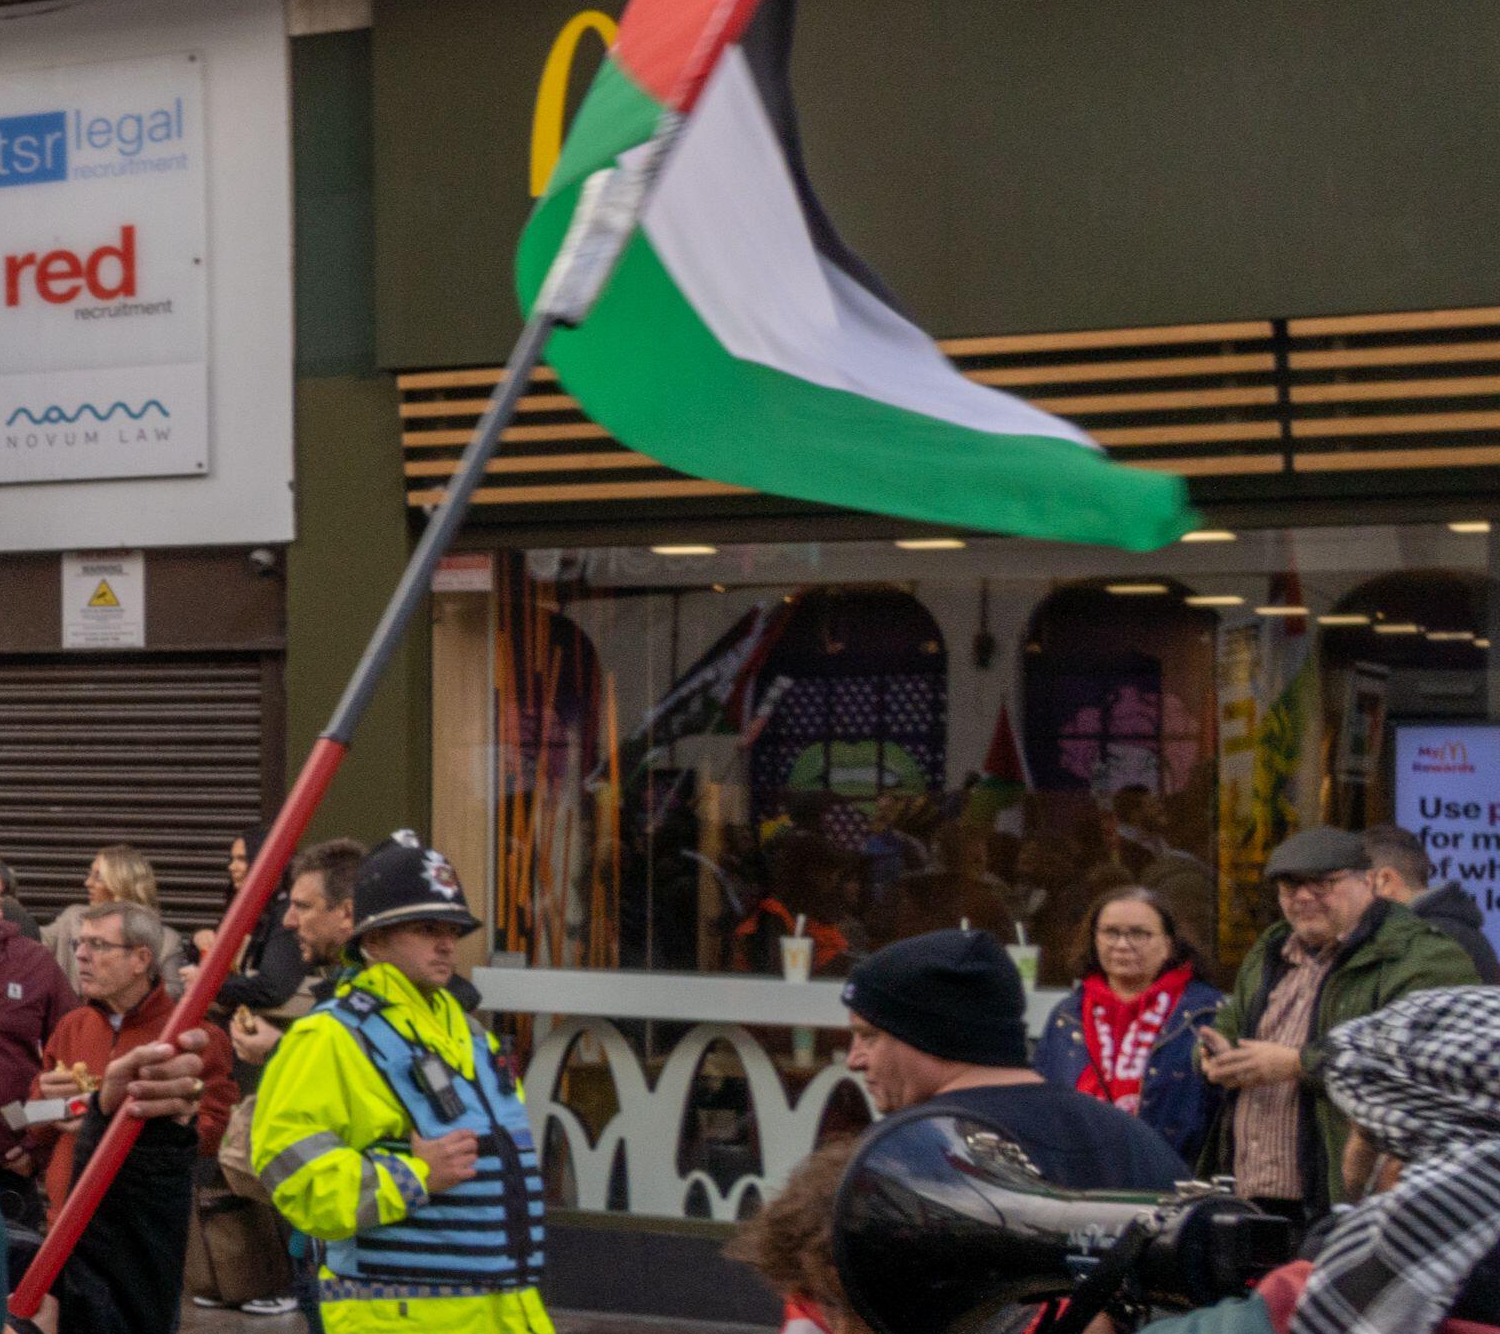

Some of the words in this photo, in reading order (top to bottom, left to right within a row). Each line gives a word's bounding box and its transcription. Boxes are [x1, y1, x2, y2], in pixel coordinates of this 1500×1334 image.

[75, 97, 183, 156] legal
[5, 225, 138, 307] red
[75, 299, 173, 320] recruitment
[6, 431, 98, 449] NOVUM
[119, 428, 171, 444] LAW
[1420, 798, 1483, 820] Use
[1421, 827, 1464, 850] for
